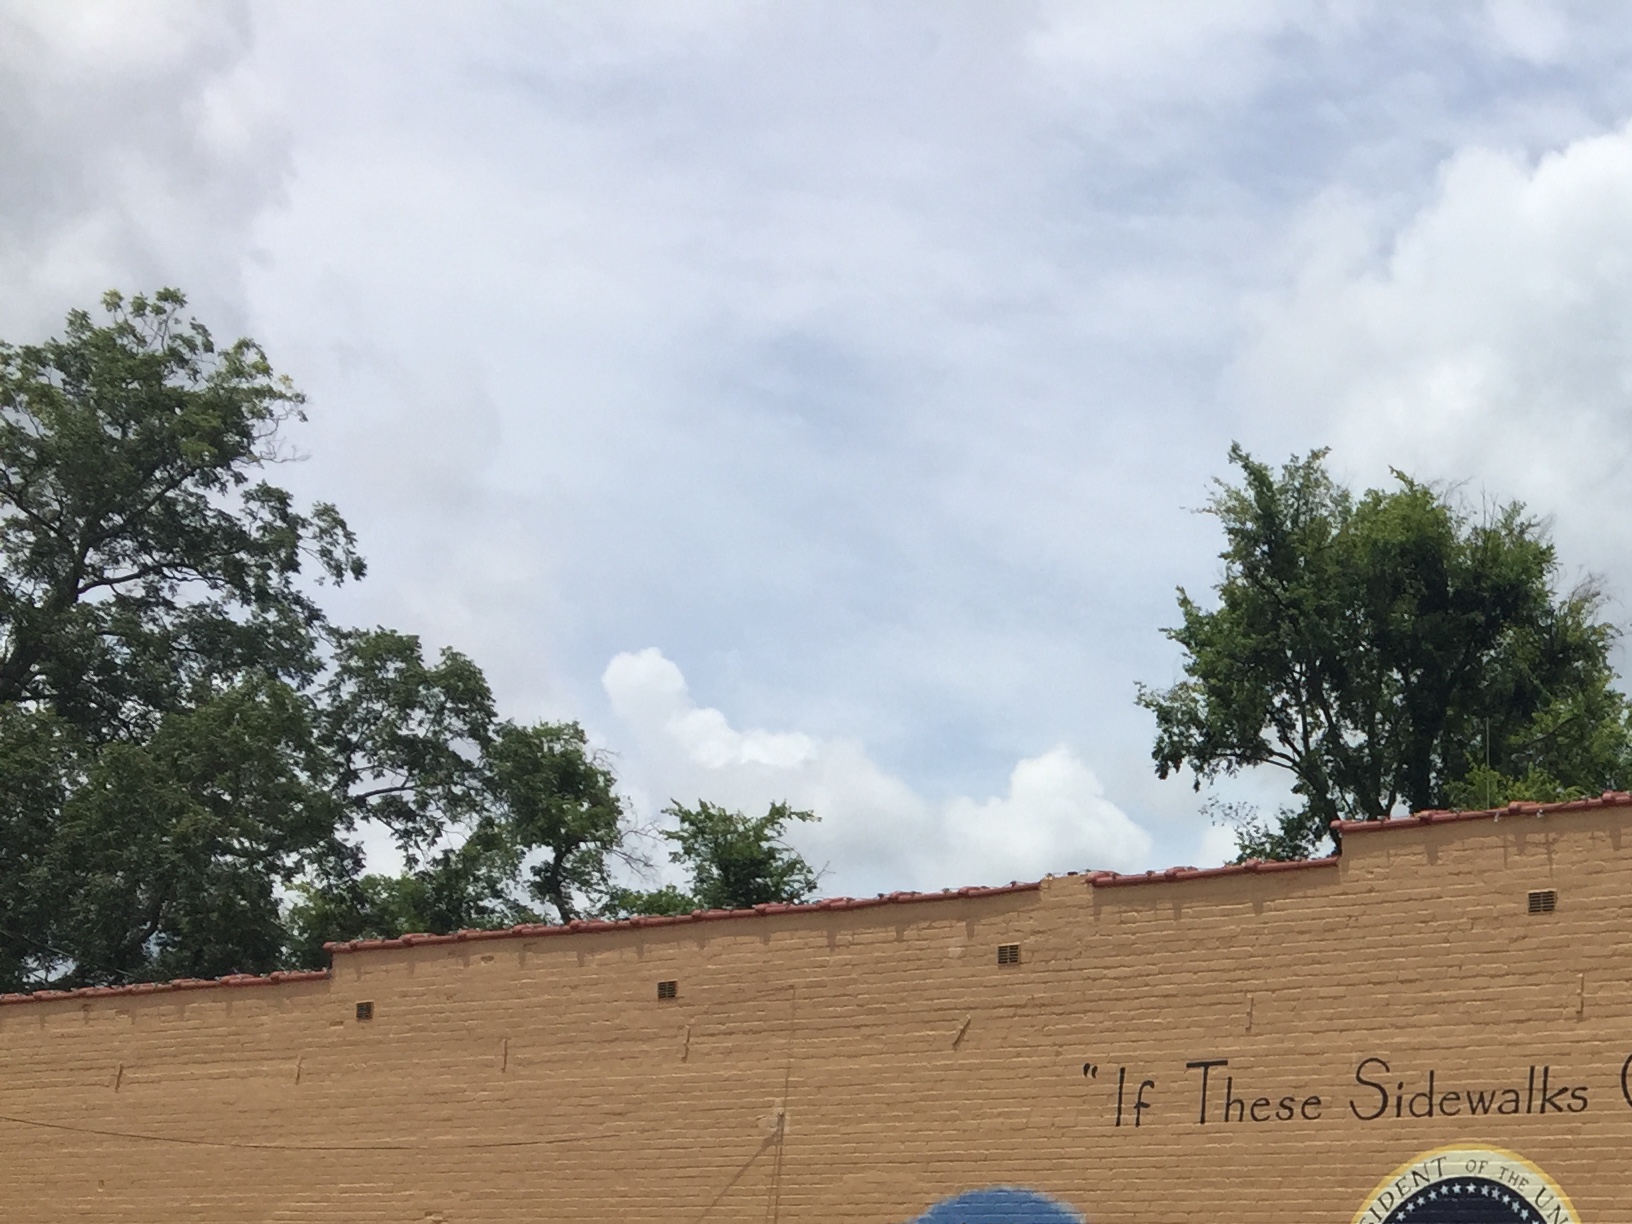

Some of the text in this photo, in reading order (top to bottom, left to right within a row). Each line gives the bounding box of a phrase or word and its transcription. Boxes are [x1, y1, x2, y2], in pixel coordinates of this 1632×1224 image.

[1186, 1059, 1323, 1124] These
[1348, 1057, 1590, 1121] Sidewalks
[1465, 1159, 1489, 1175] OF
[1499, 1167, 1530, 1192] THE
